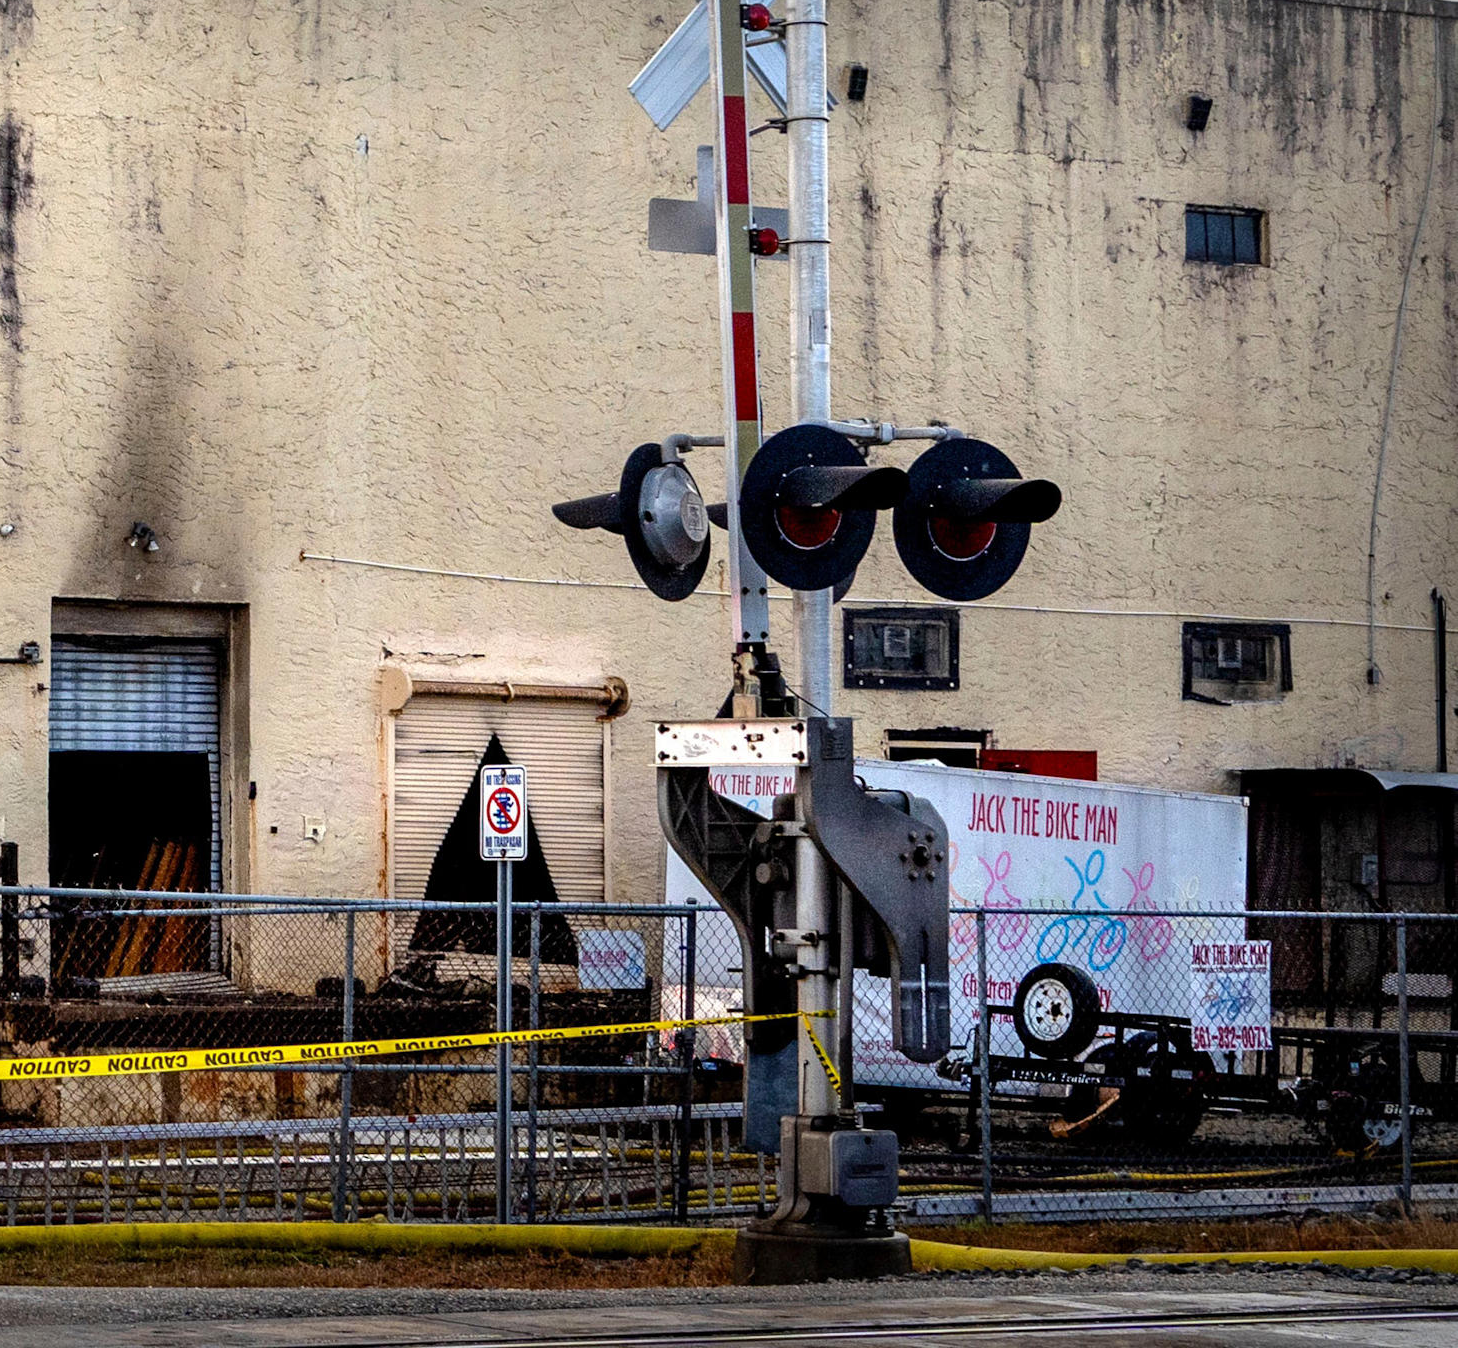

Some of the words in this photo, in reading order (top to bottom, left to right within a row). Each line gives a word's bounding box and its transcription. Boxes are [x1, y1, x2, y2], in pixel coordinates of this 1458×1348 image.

[708, 773, 728, 795] ACK
[731, 774, 752, 797] THE
[755, 775, 780, 797] BIKE
[967, 792, 1007, 834] JACK
[1012, 796, 1040, 837] THE
[1045, 800, 1080, 841] BIKE
[1084, 803, 1118, 846] MAN
[1191, 944, 1210, 965] JACK
[1212, 944, 1227, 965] THE
[1229, 944, 1248, 965] BIKE
[1249, 944, 1268, 965] MAN
[204, 1049, 285, 1066] CAUTION
[300, 1043, 379, 1059] CAUTION
[9, 1059, 91, 1077] CAUTION
[107, 1054, 188, 1072] CAUTION
